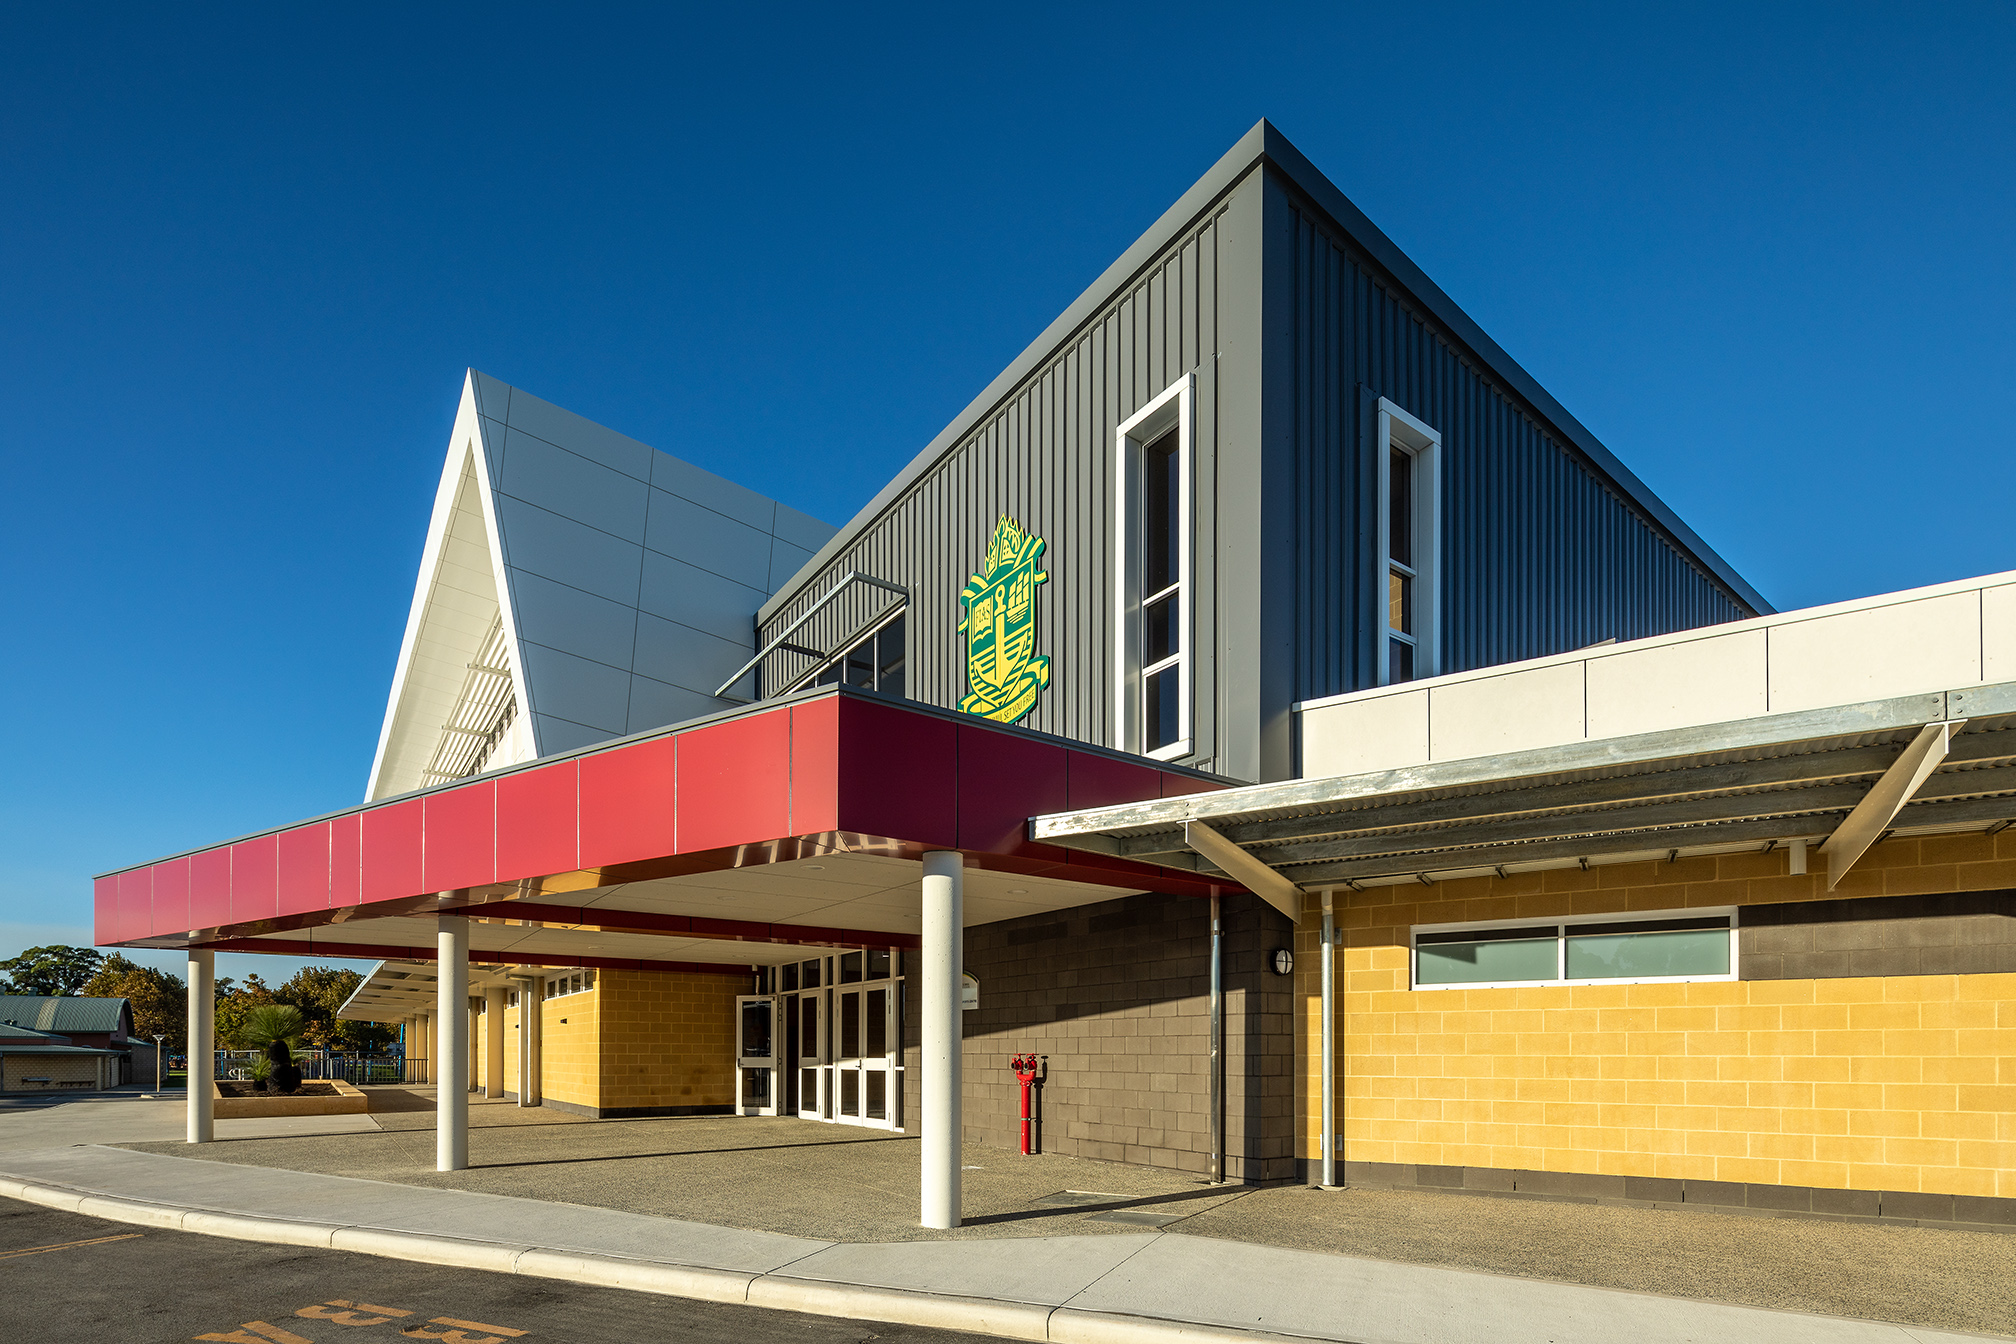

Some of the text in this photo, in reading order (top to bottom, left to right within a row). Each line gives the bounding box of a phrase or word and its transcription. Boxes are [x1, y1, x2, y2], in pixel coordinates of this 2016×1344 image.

[1003, 707, 1013, 721] SET
[1012, 699, 1023, 715] YOU
[1023, 688, 1035, 707] FREE
